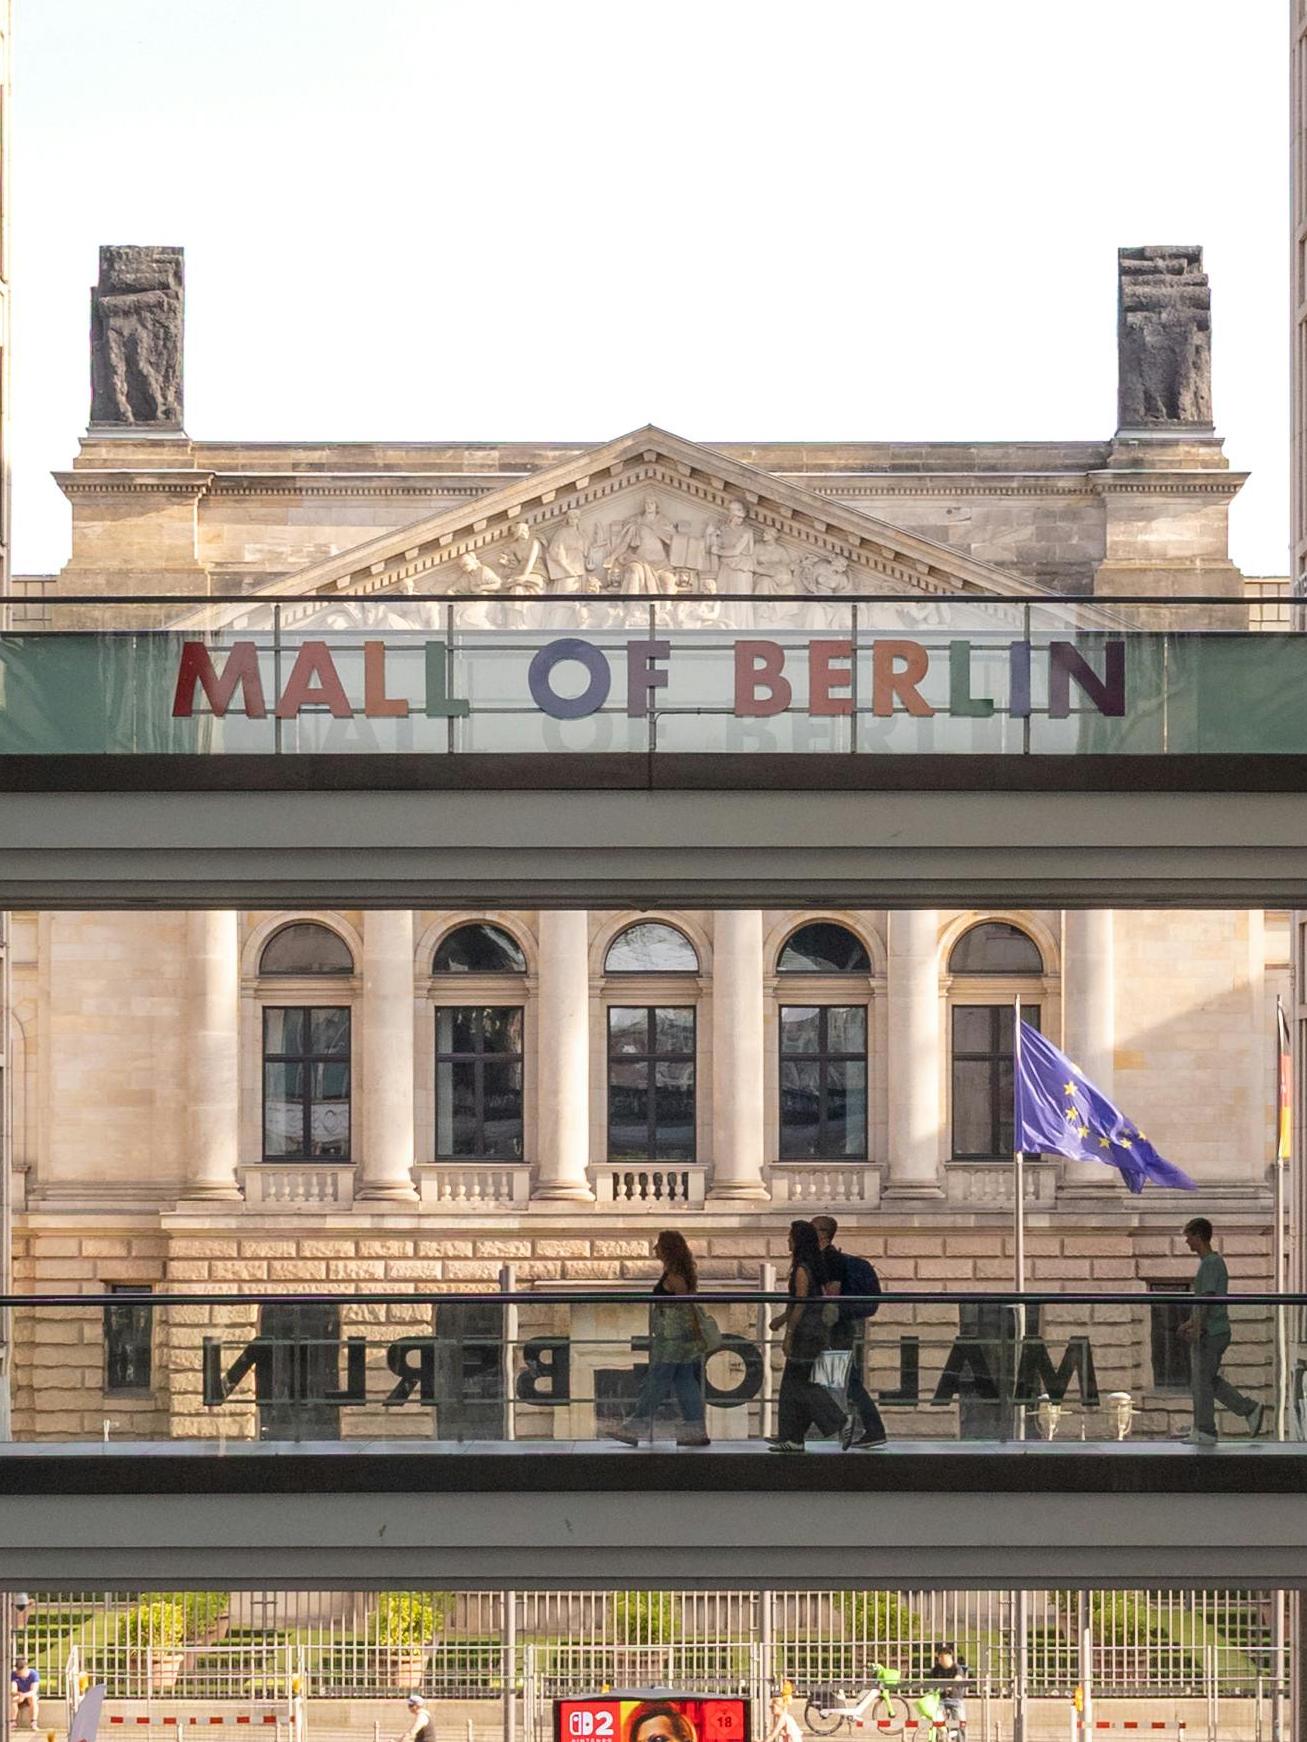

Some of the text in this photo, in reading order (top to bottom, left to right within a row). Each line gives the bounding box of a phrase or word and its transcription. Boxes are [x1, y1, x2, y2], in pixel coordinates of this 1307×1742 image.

[172, 637, 1125, 720] MALL OF BERLIN
[717, 1716, 732, 1728] 18
